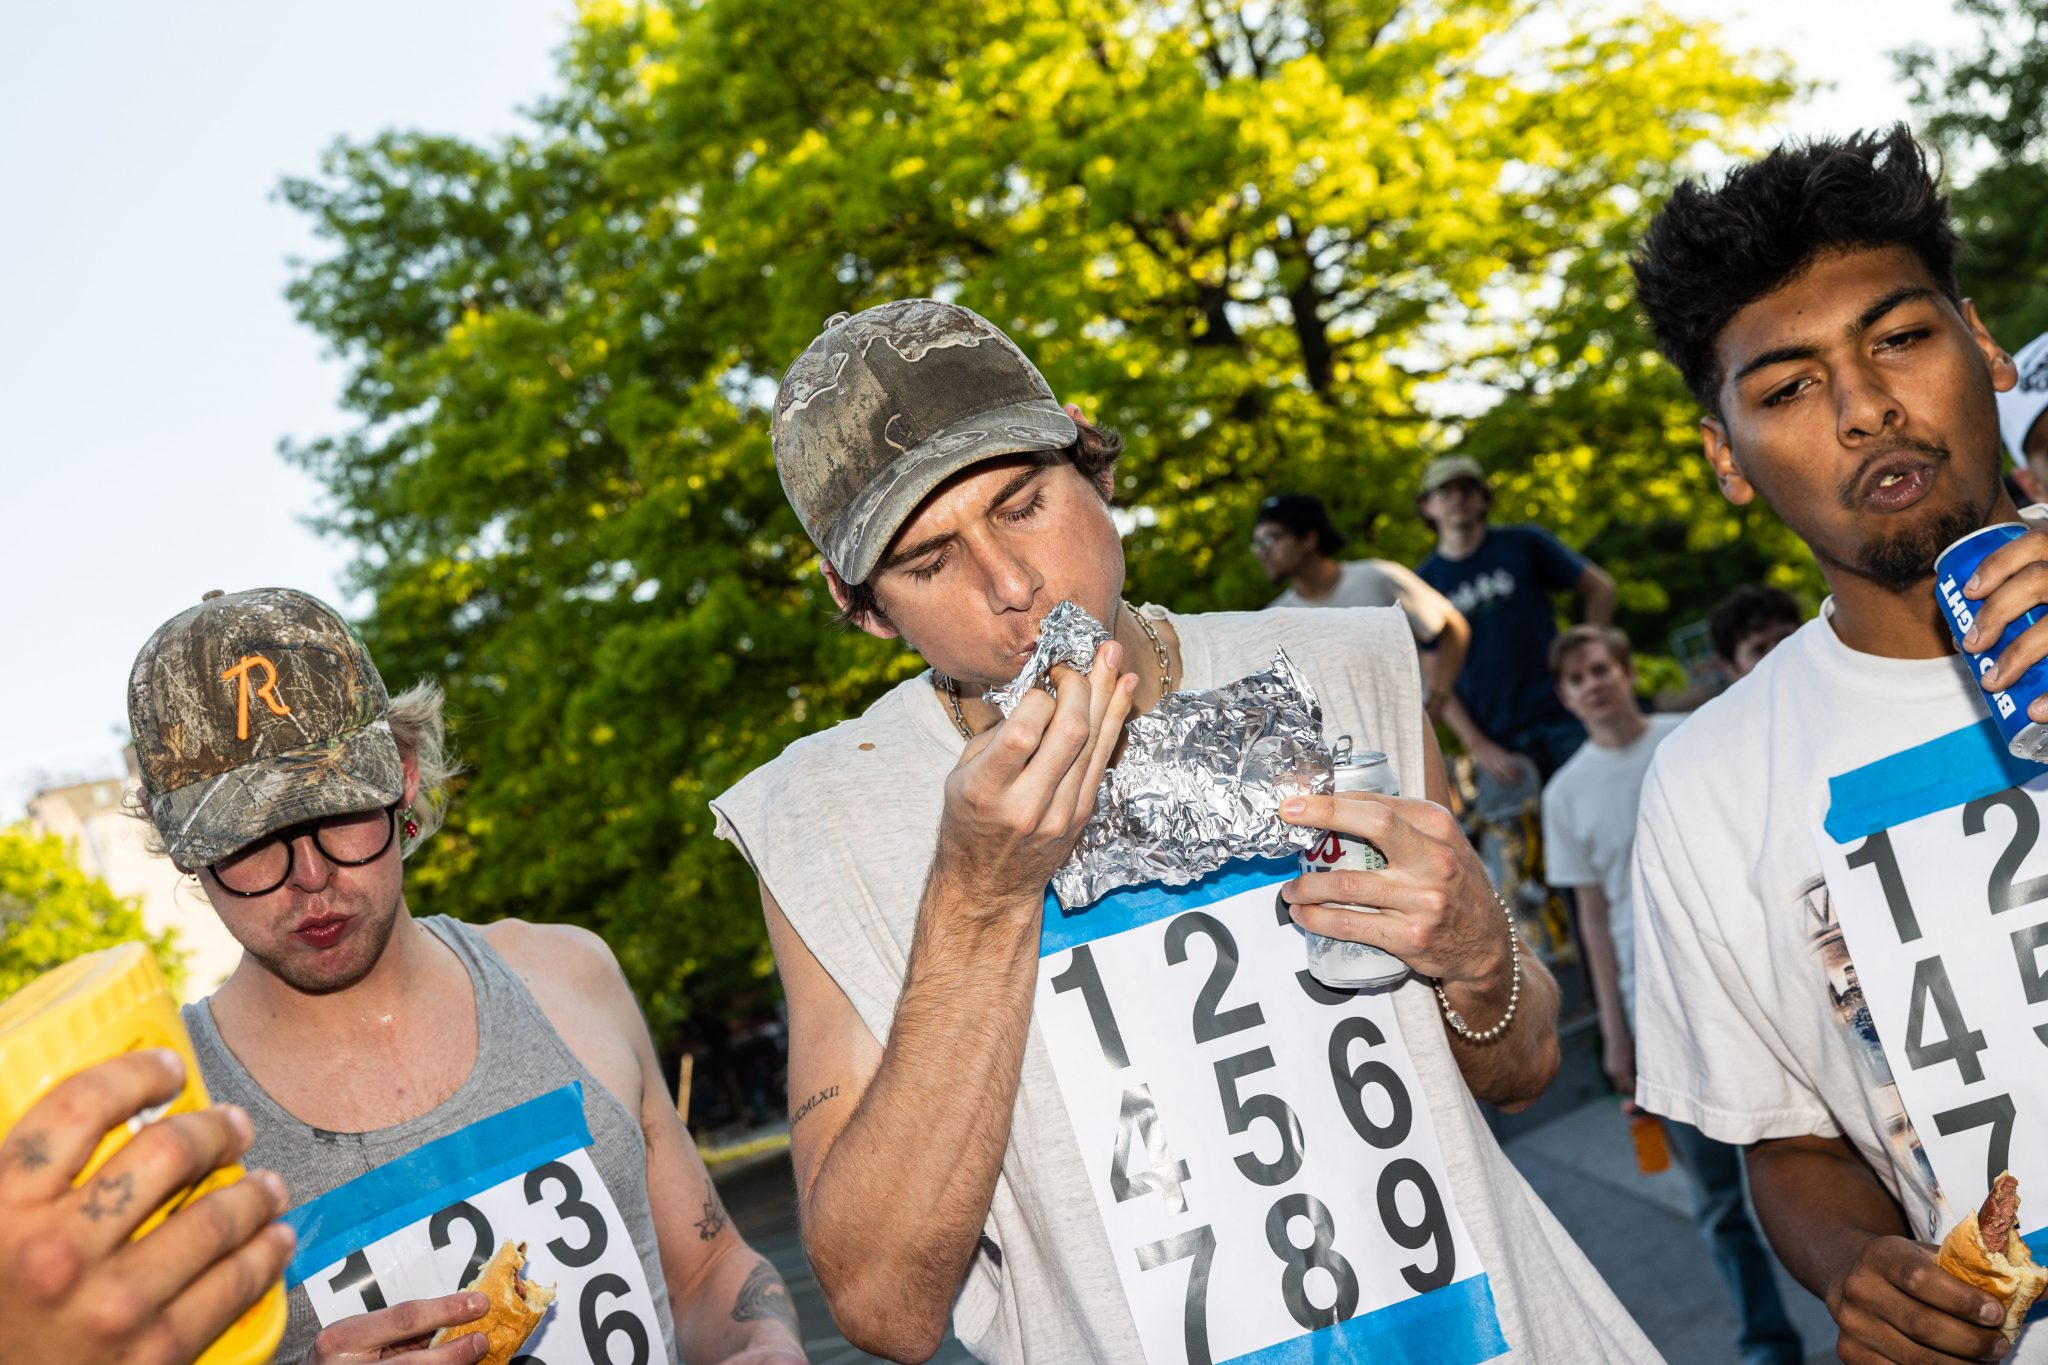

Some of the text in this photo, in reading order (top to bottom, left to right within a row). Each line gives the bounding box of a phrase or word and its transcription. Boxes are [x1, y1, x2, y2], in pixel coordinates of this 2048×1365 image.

[221, 655, 291, 740] R
[1979, 657, 2017, 720] BD
[1845, 786, 2048, 945] 1 2
[1051, 943, 1131, 1072] 1
[1164, 911, 1266, 1045] 2
[1904, 954, 1989, 1086] 4
[1110, 1016, 1413, 1217] 4 5 6
[1932, 1092, 2019, 1205] 7
[327, 1161, 609, 1313] 1 2 3
[1134, 1157, 1456, 1365] 7 8 9
[579, 1272, 650, 1365] 6
